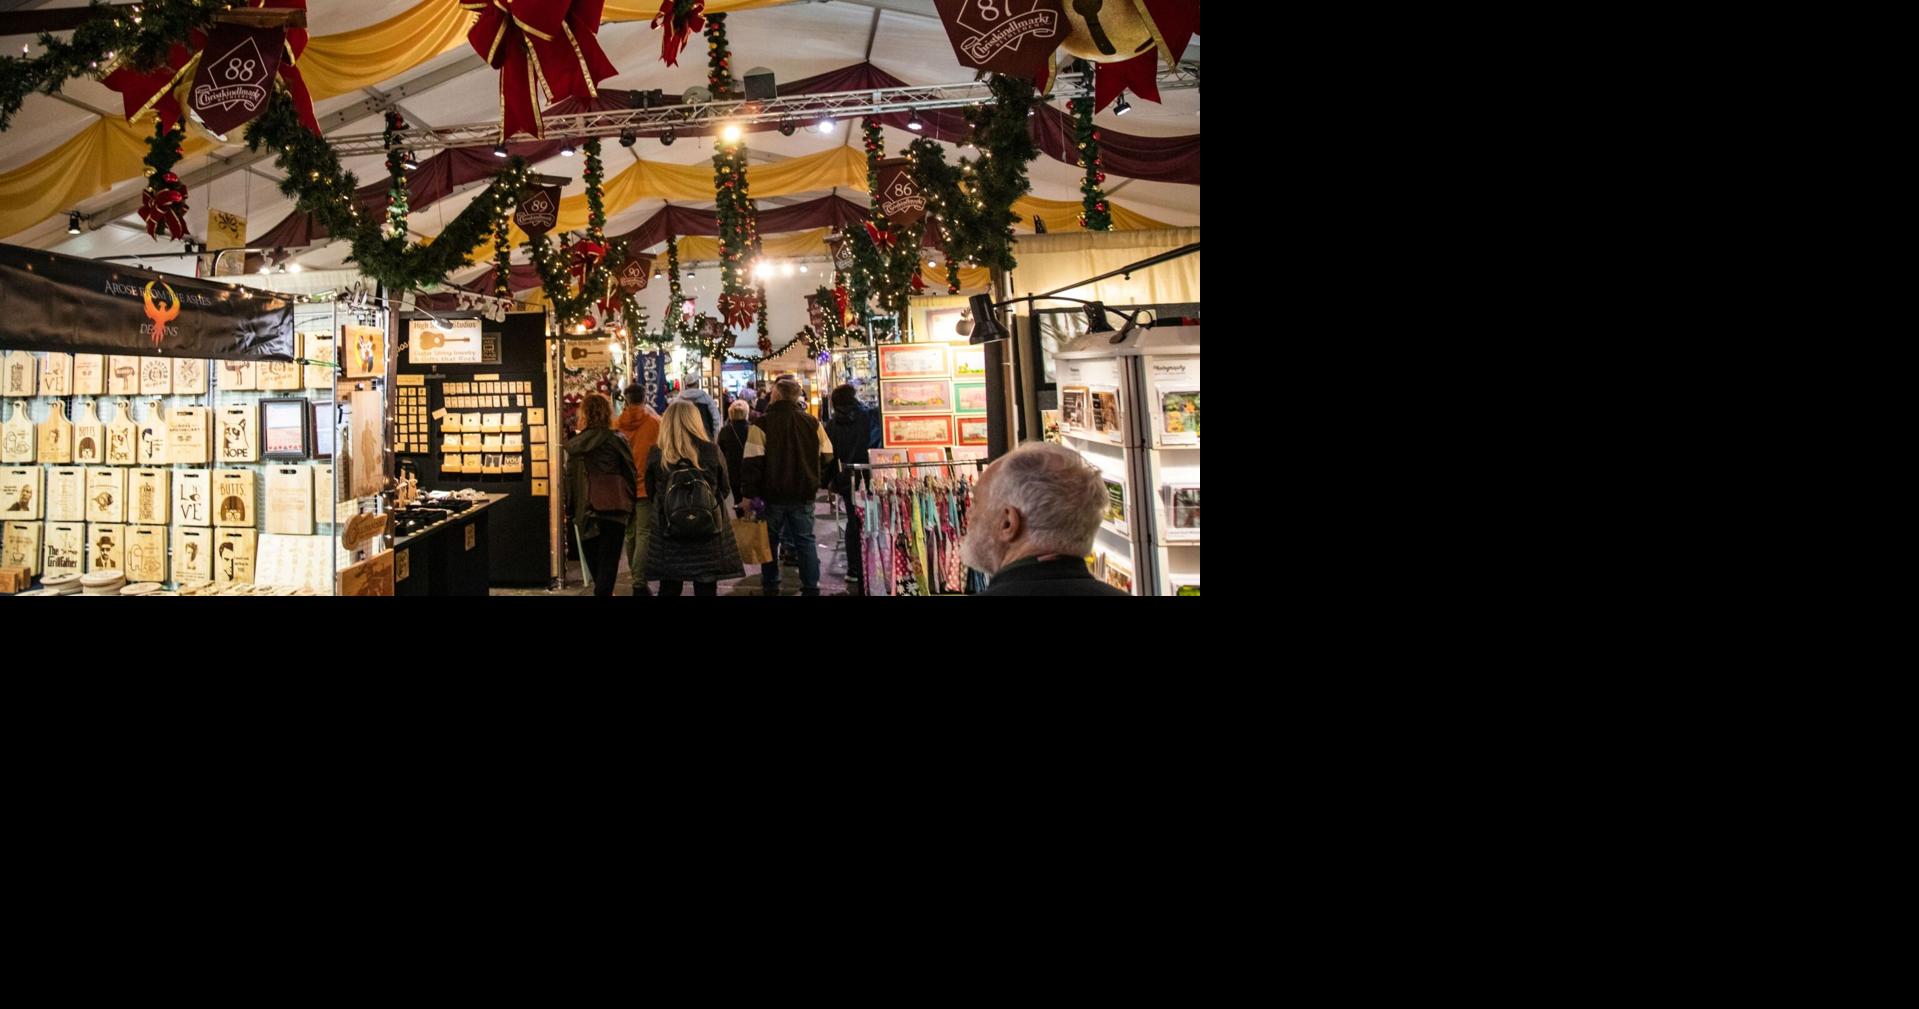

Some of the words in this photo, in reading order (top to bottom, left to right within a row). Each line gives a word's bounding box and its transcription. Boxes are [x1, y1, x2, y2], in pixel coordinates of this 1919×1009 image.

[972, 12, 1051, 59] Christkindlmarkt
[225, 57, 256, 81] 88
[894, 183, 912, 197] 86
[531, 200, 548, 212] 89
[628, 267, 640, 277] 90
[104, 280, 138, 297] AROSE
[186, 295, 212, 306] ASHES
[140, 323, 179, 337] DENS
[223, 448, 248, 458] NOPE
[48, 545, 59, 556] The
